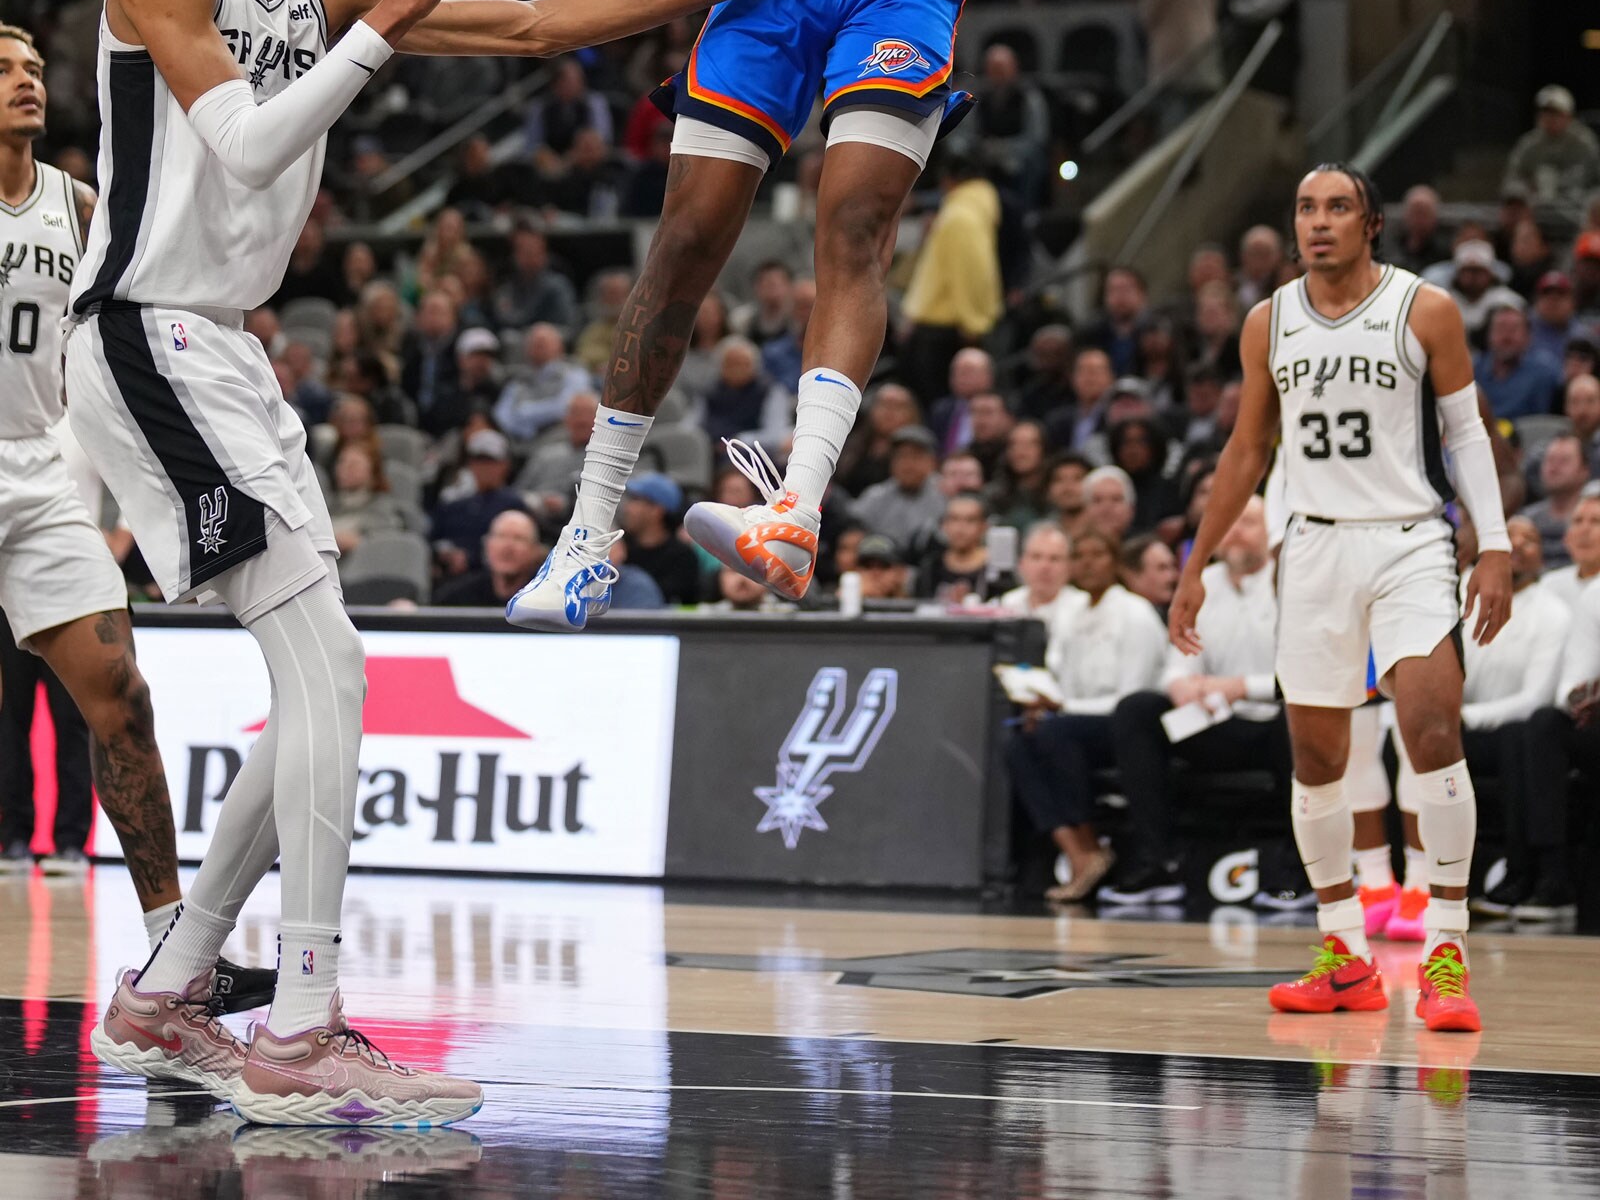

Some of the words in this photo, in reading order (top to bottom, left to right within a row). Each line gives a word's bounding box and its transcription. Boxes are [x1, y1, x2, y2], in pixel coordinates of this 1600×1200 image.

[868, 47, 910, 68] OKC
[42, 215, 67, 230] Self.
[1363, 319, 1392, 332] Self.
[1276, 356, 1397, 399] SPURS
[1300, 411, 1372, 459] 33
[1207, 848, 1259, 904] G
